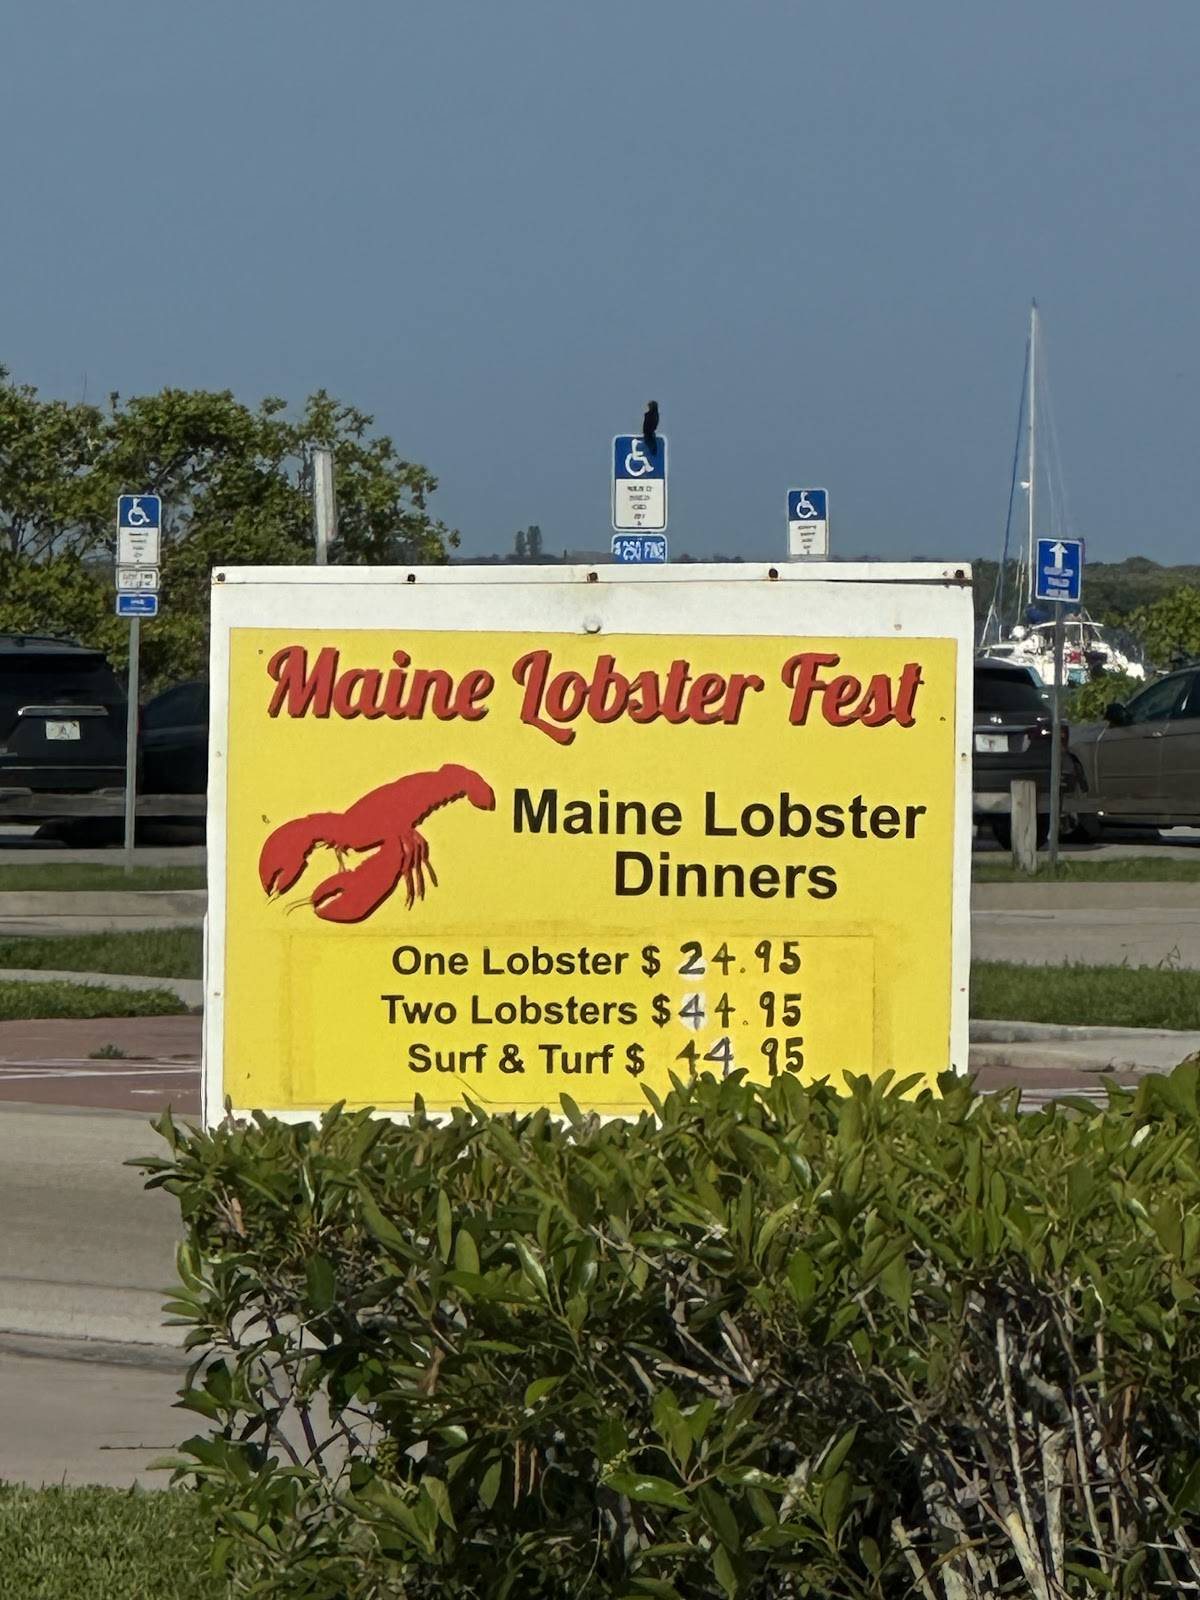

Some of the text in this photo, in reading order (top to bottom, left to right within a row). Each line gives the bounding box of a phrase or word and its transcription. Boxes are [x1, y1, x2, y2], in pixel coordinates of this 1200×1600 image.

[267, 645, 925, 746] Maine Lobster Fest
[513, 788, 927, 839] Maine Lobster
[615, 850, 838, 900] Dinners
[392, 945, 469, 976] One
[483, 945, 630, 976] Lobster
[380, 994, 457, 1025] Two
[471, 994, 638, 1025] Lobsters
[408, 1043, 488, 1074] Surf
[498, 1043, 526, 1074] &
[538, 1043, 615, 1074] Turf
